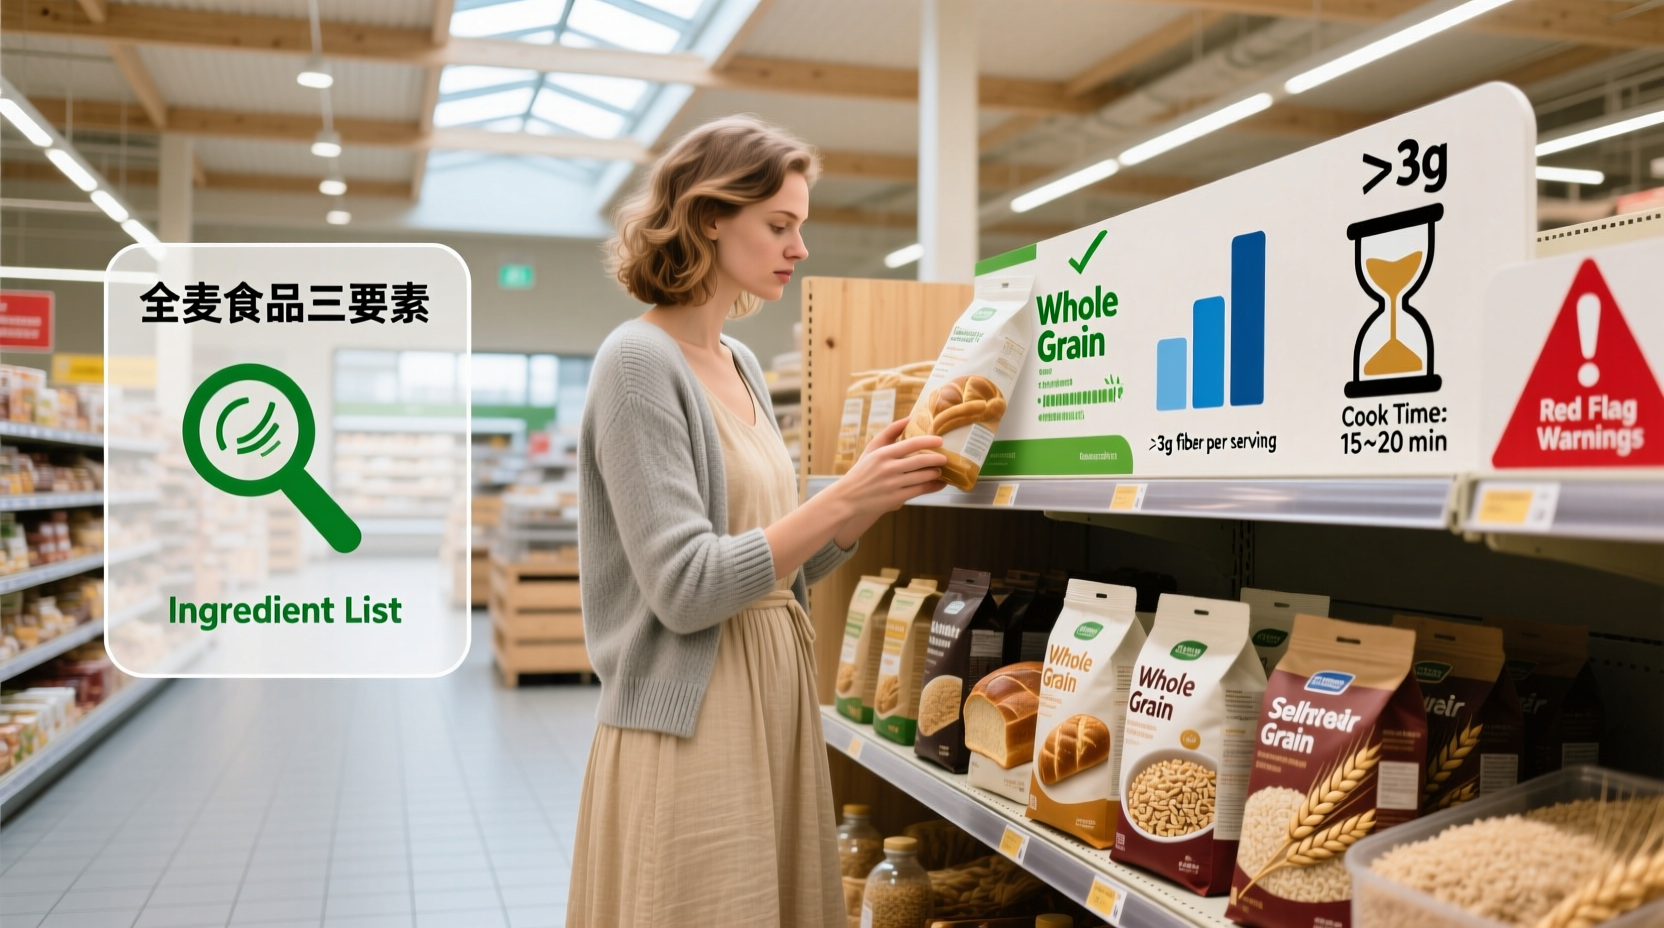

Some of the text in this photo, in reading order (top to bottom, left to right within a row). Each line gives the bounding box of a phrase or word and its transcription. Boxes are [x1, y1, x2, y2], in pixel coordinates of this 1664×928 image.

[1362, 139, 1448, 195] >3g
[1036, 285, 1119, 326] Whole
[1037, 325, 1106, 363] Grain
[1341, 402, 1447, 427] Cook Time:
[1539, 394, 1638, 427] Red Flag
[1149, 430, 1277, 456] >3g fiber per serving
[1340, 428, 1447, 455] 15~20 min
[1536, 424, 1645, 457] Warnings
[1048, 644, 1093, 673] Whole
[1042, 667, 1078, 693] Grain
[1138, 665, 1196, 698] Whole
[1129, 690, 1174, 721] Grain
[1260, 722, 1315, 755] Grain
